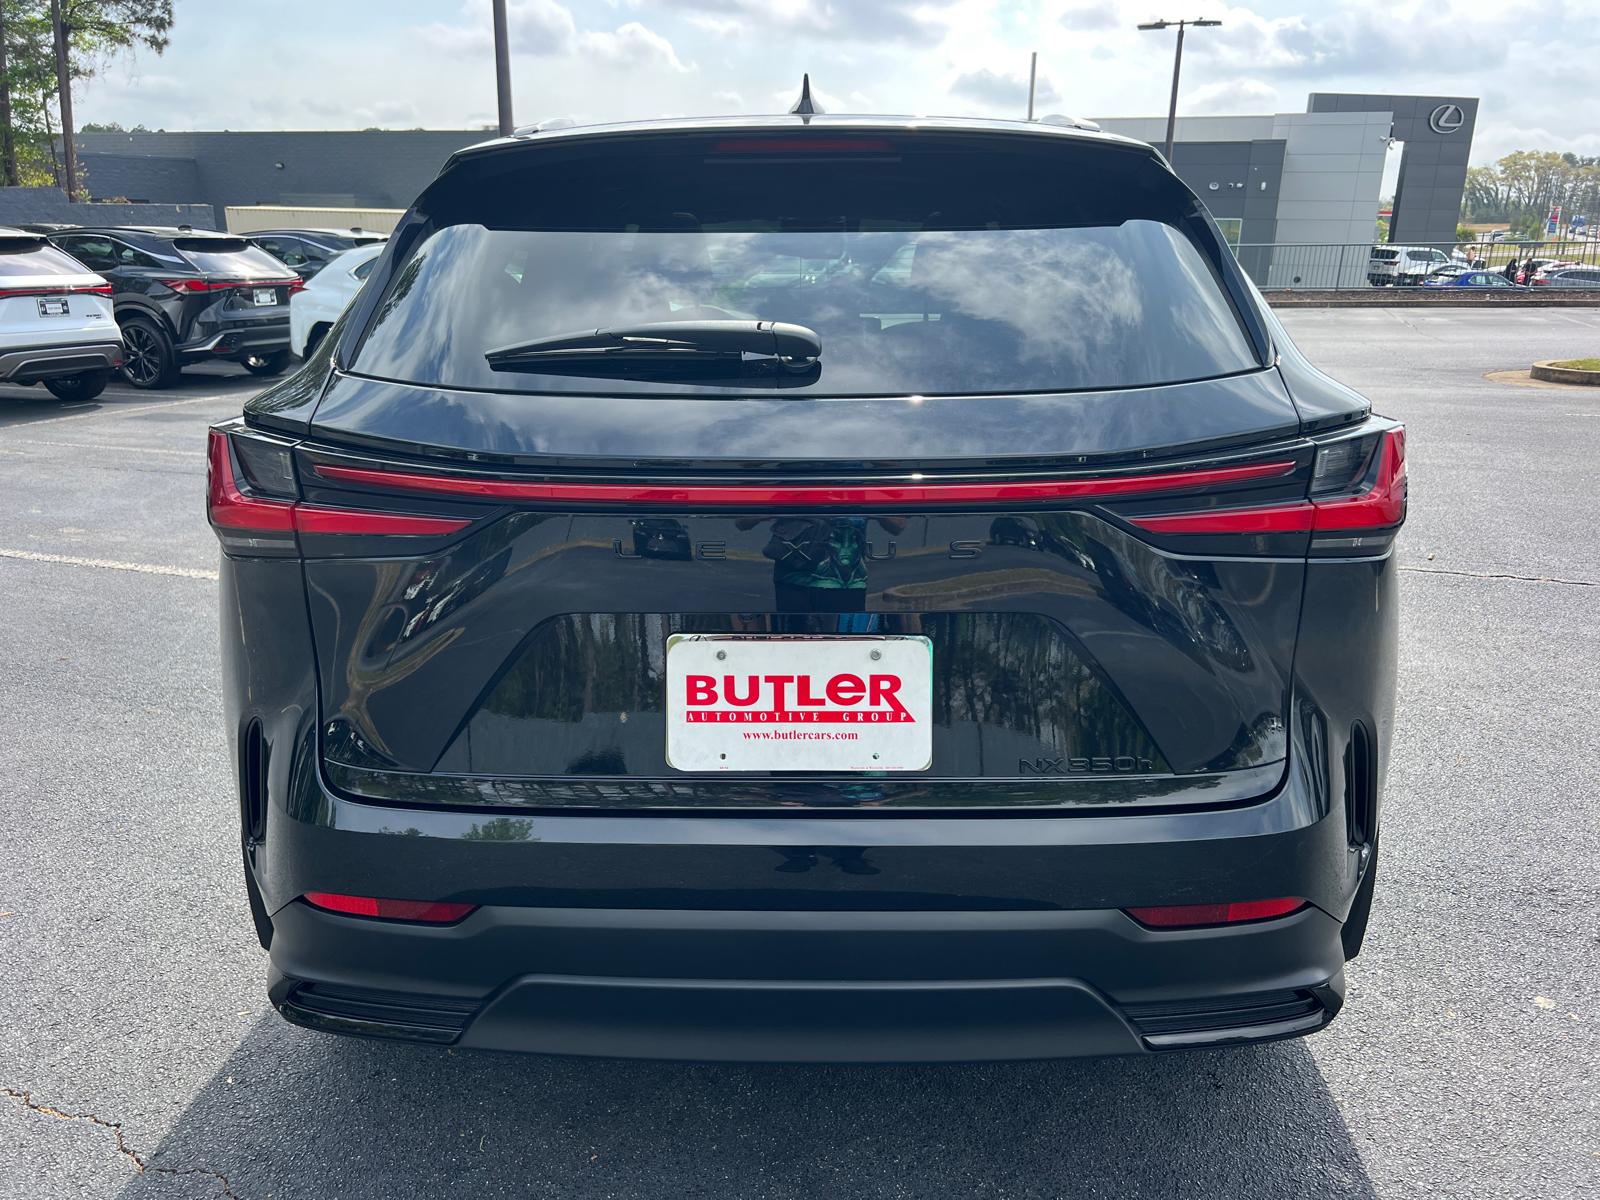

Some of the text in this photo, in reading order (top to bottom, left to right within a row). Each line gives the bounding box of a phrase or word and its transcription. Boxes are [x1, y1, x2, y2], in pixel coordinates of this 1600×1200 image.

[612, 540, 983, 561] LEXUS
[687, 712, 907, 722] AUTOMOTIVE GROUP
[743, 730, 859, 740] www.butlercars.com
